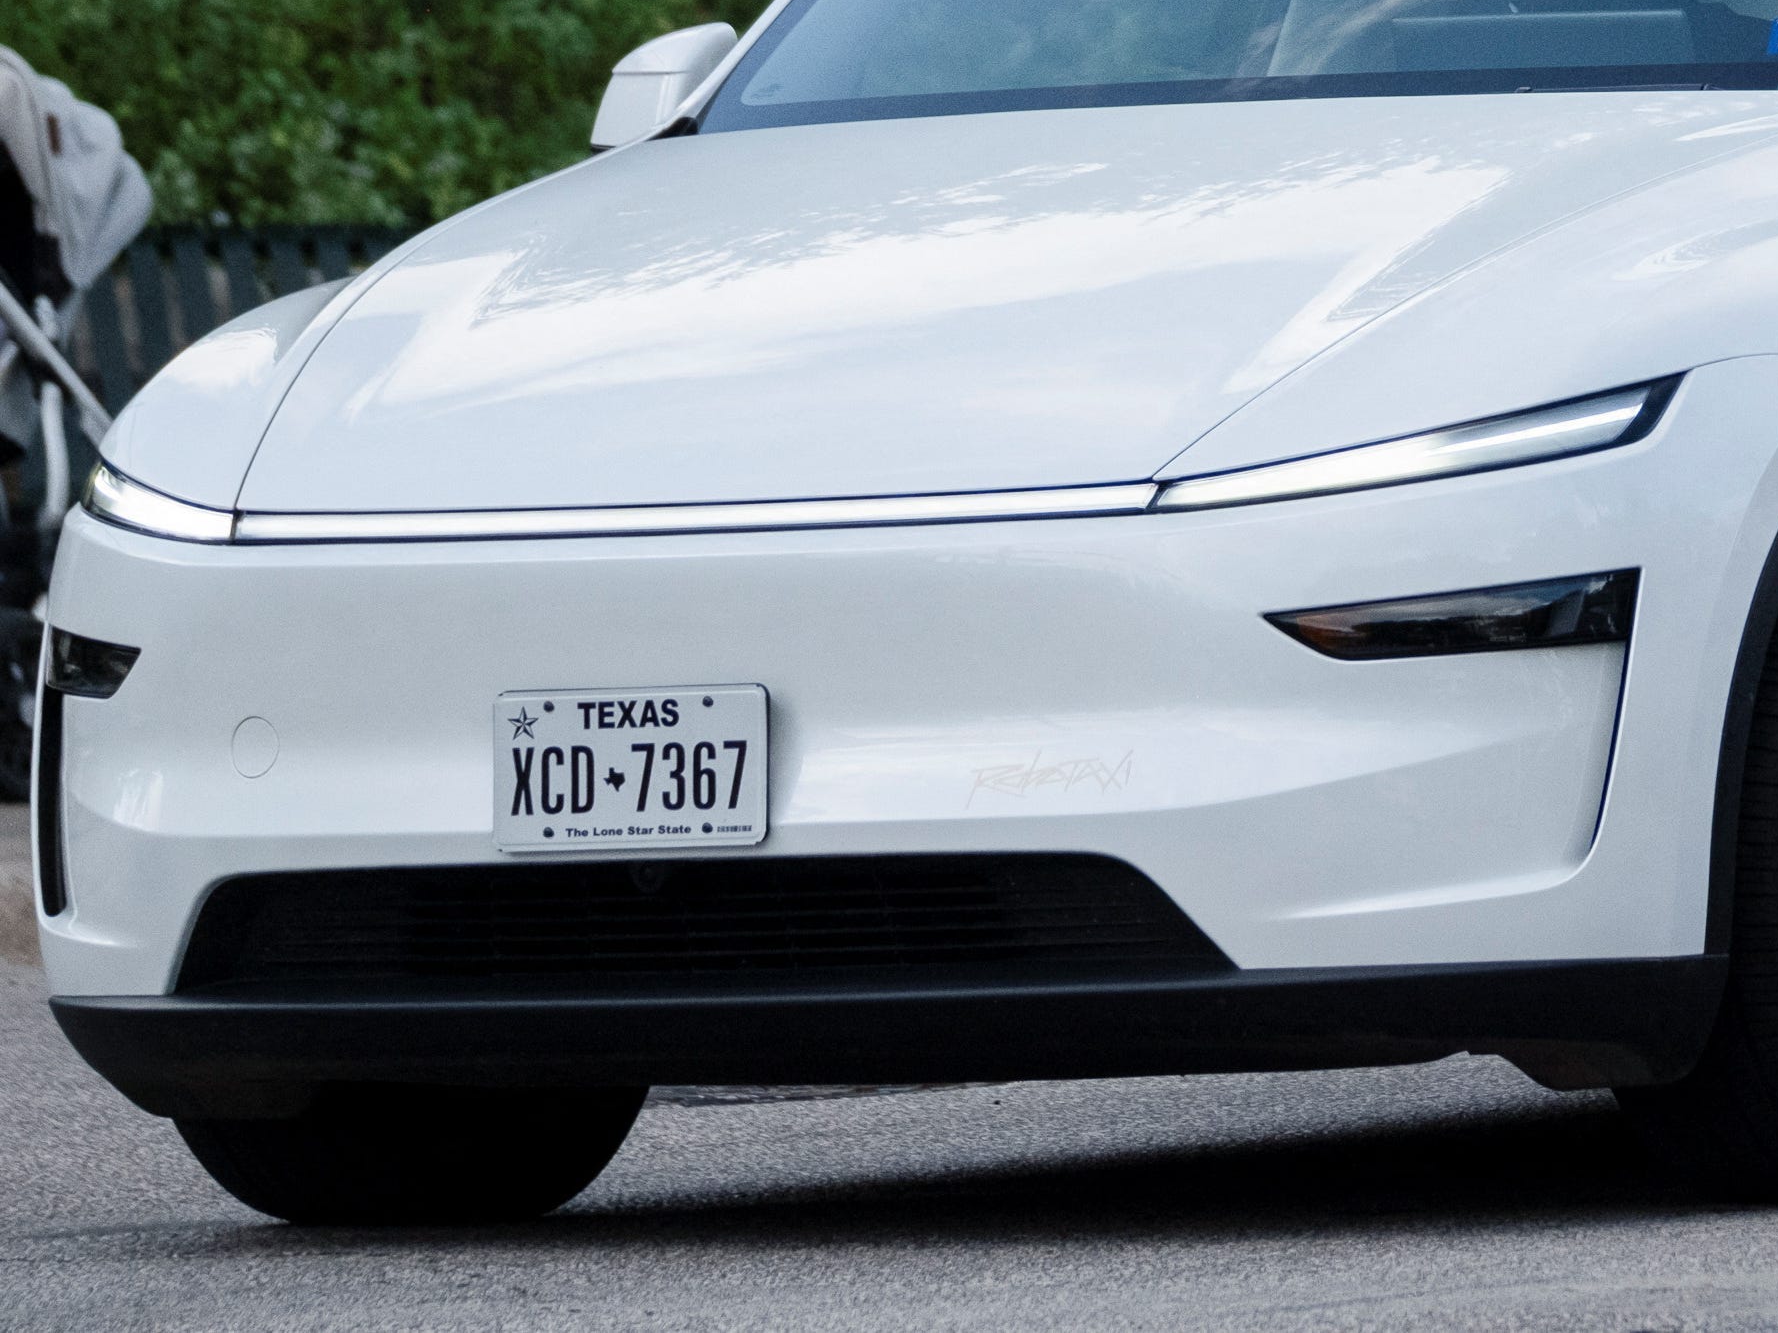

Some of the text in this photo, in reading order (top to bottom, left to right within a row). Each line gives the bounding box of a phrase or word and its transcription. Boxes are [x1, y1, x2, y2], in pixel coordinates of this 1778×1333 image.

[577, 698, 680, 730] TEXAS
[511, 740, 747, 816] XCD 7367
[565, 825, 692, 837] The Lone Star State
